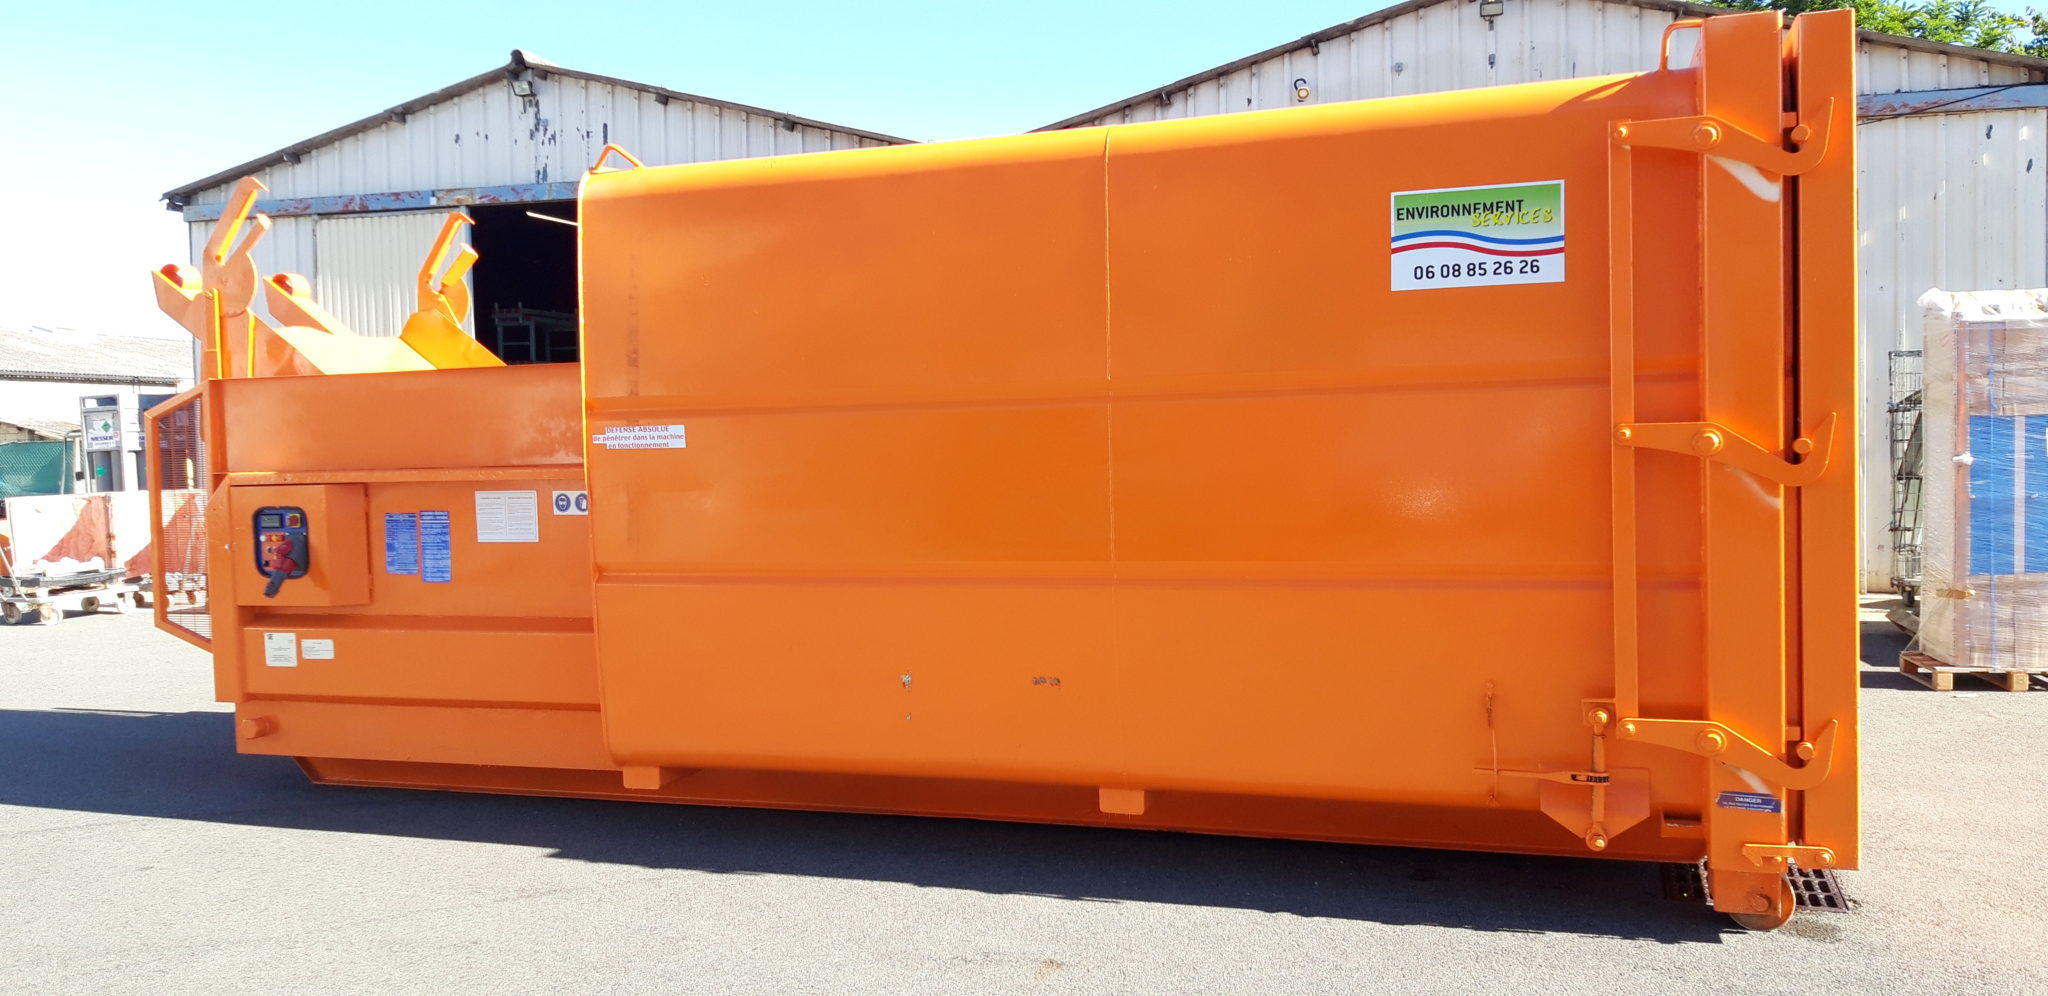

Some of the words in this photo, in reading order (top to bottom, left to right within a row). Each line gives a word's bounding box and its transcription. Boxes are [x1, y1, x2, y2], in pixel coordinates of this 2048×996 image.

[1396, 199, 1524, 221] ENVIRONNEMENT
[1471, 208, 1553, 227] SERVICES
[1413, 265, 1435, 280] 06
[1440, 263, 1462, 278] 08
[1466, 262, 1487, 277] 85
[1492, 260, 1514, 275] 26
[1519, 259, 1540, 274] 26
[637, 425, 670, 433] ABSOLUE
[656, 432, 684, 440] machine
